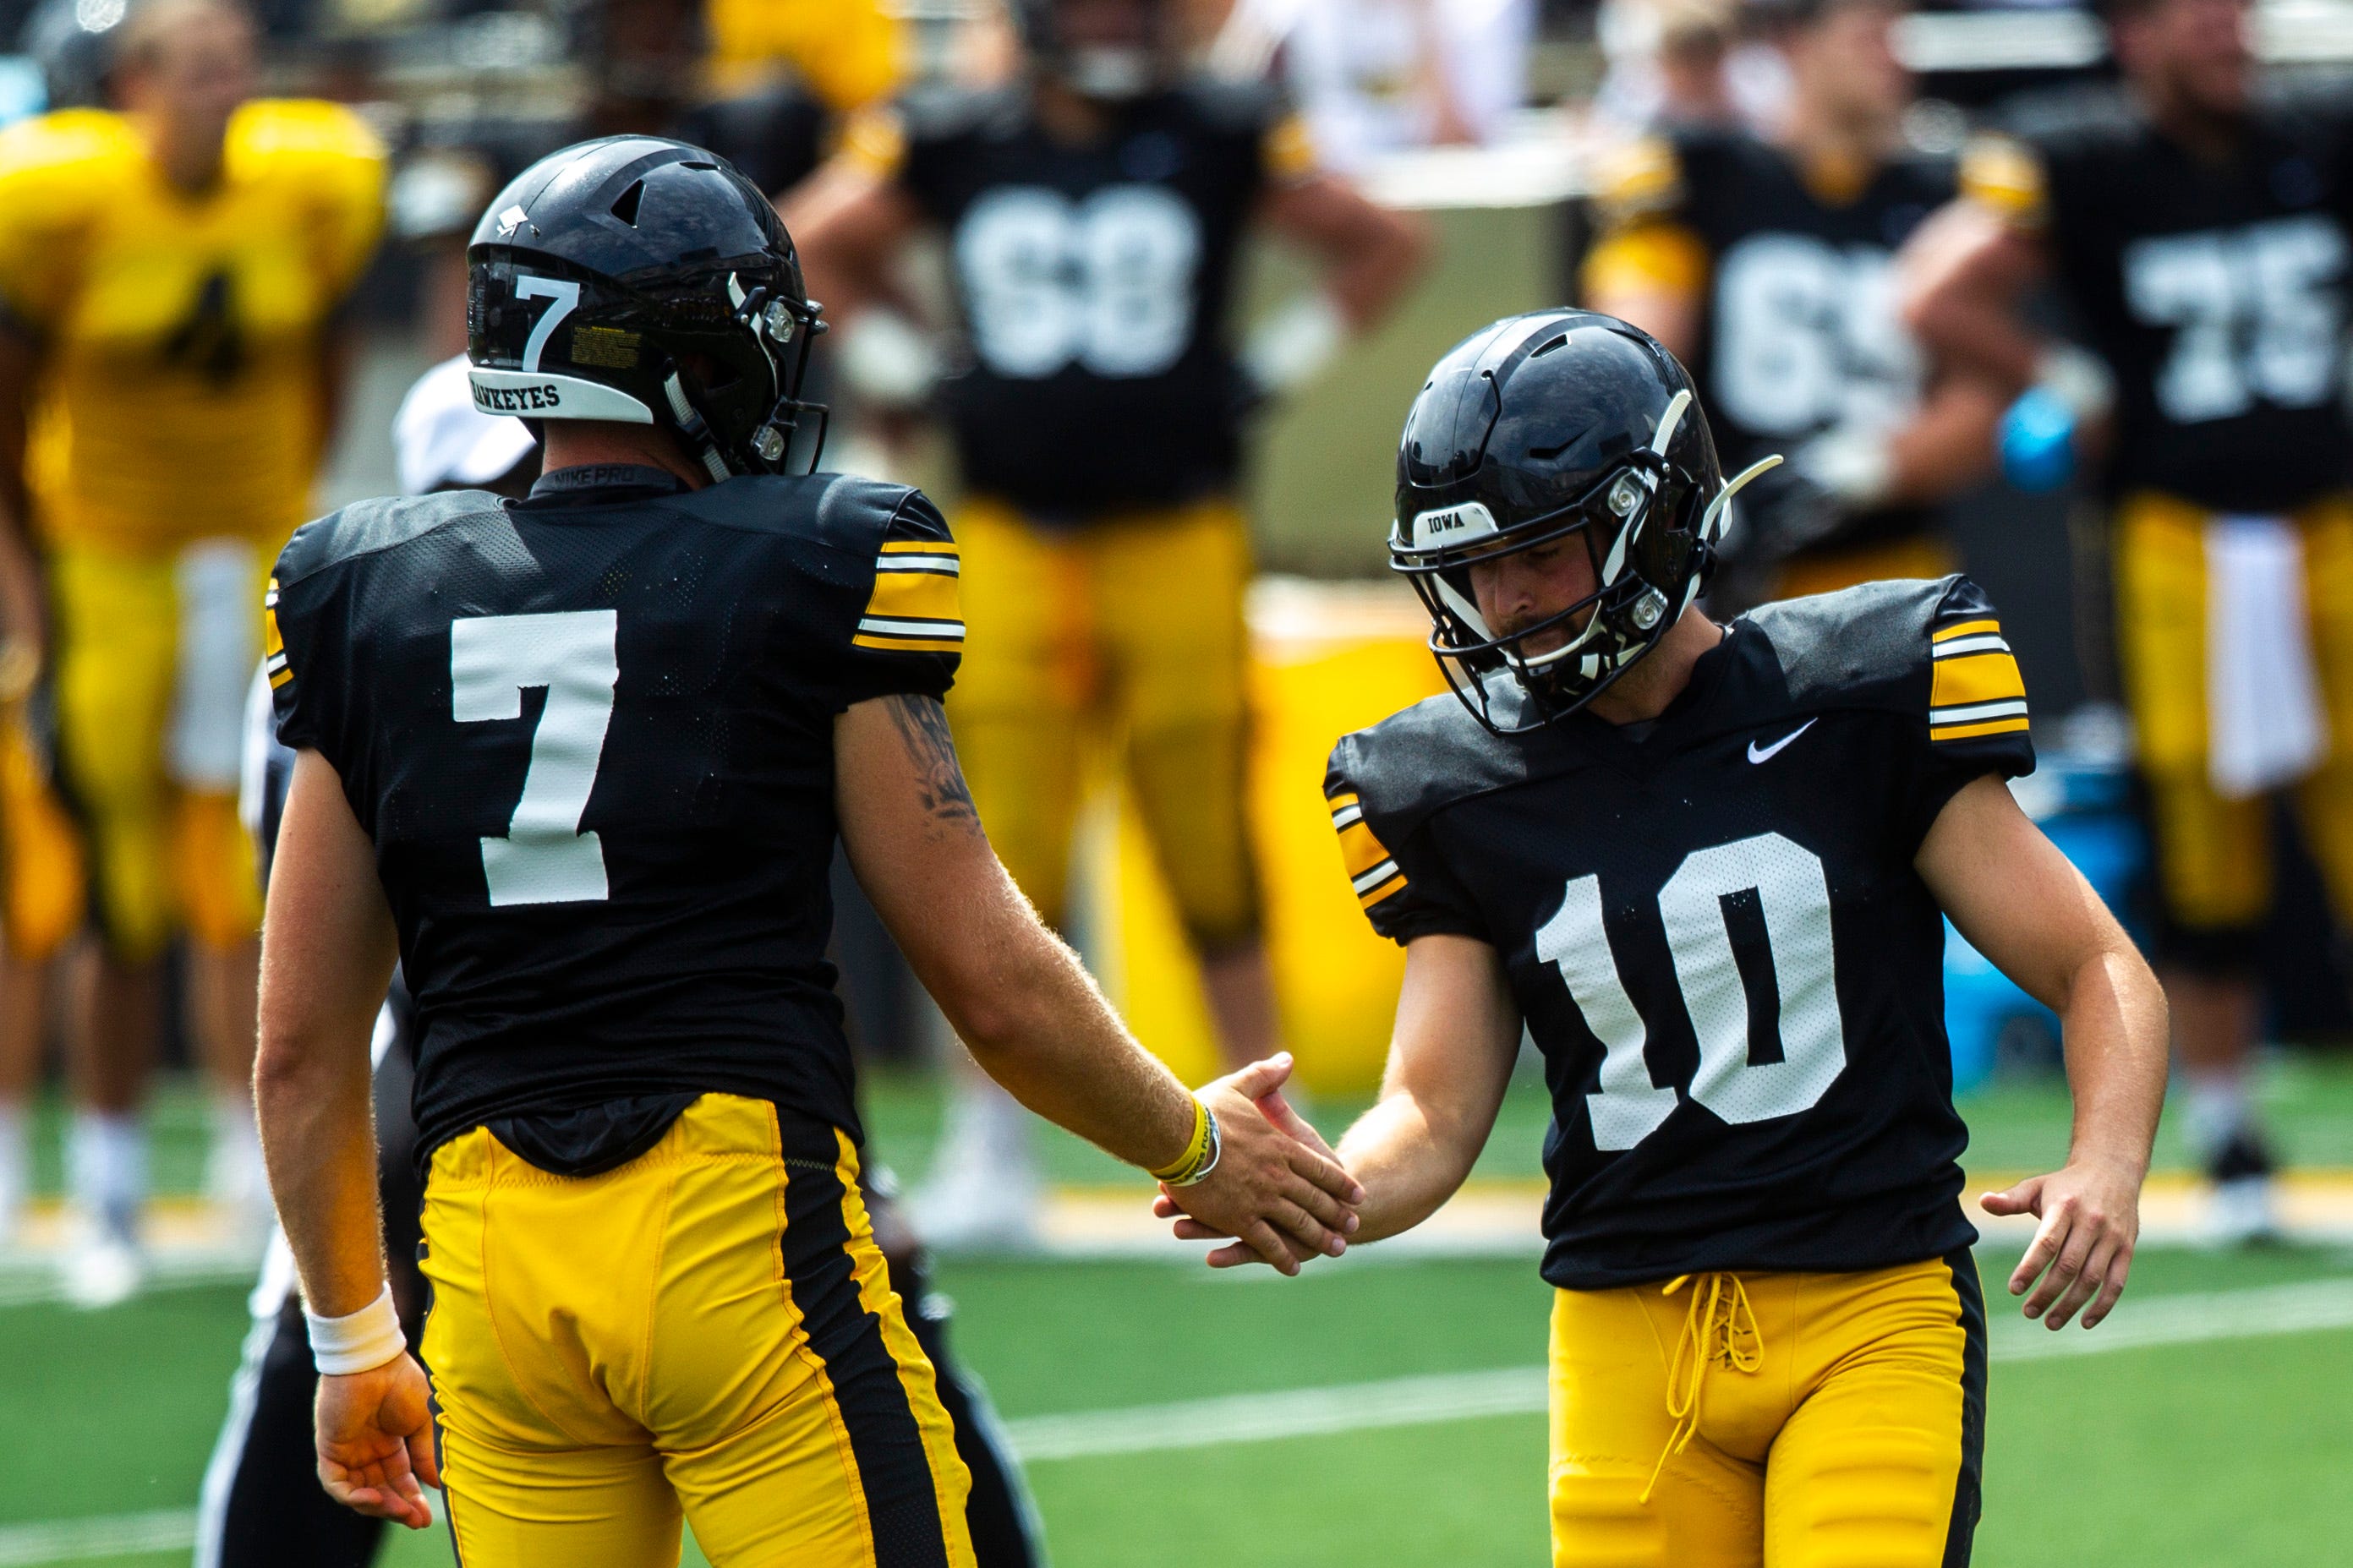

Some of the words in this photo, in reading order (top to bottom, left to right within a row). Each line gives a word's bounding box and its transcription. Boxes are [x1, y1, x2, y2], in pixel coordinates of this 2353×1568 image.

[516, 275, 580, 373] 7
[2120, 217, 2346, 422] 75
[555, 467, 593, 484] NIKE
[594, 467, 635, 484] PRO
[1427, 511, 1465, 533] IOWA
[451, 609, 619, 906] 7
[1535, 831, 1847, 1151] 10
